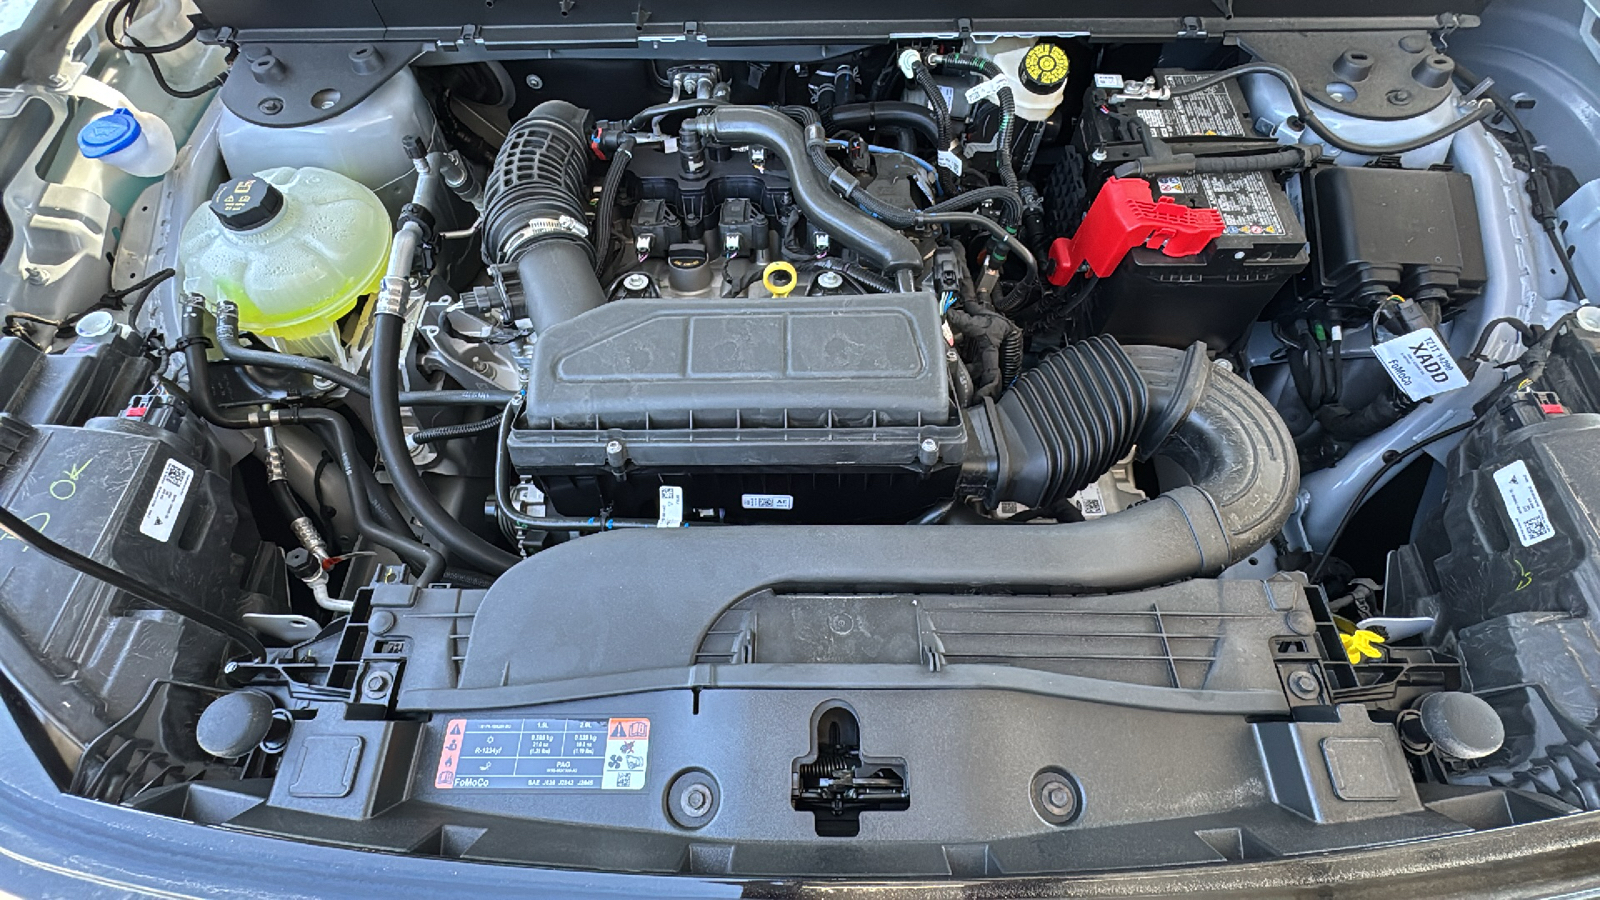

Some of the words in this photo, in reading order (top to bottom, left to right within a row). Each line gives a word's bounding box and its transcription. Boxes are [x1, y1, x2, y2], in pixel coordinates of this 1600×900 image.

[1408, 342, 1449, 383] XADD
[1388, 359, 1412, 386] FoMoCo
[49, 457, 94, 501] OK
[546, 734, 554, 743] kg
[589, 734, 597, 743] kg
[475, 747, 503, 756] R-1234yf
[454, 778, 489, 787] FoMoCo
